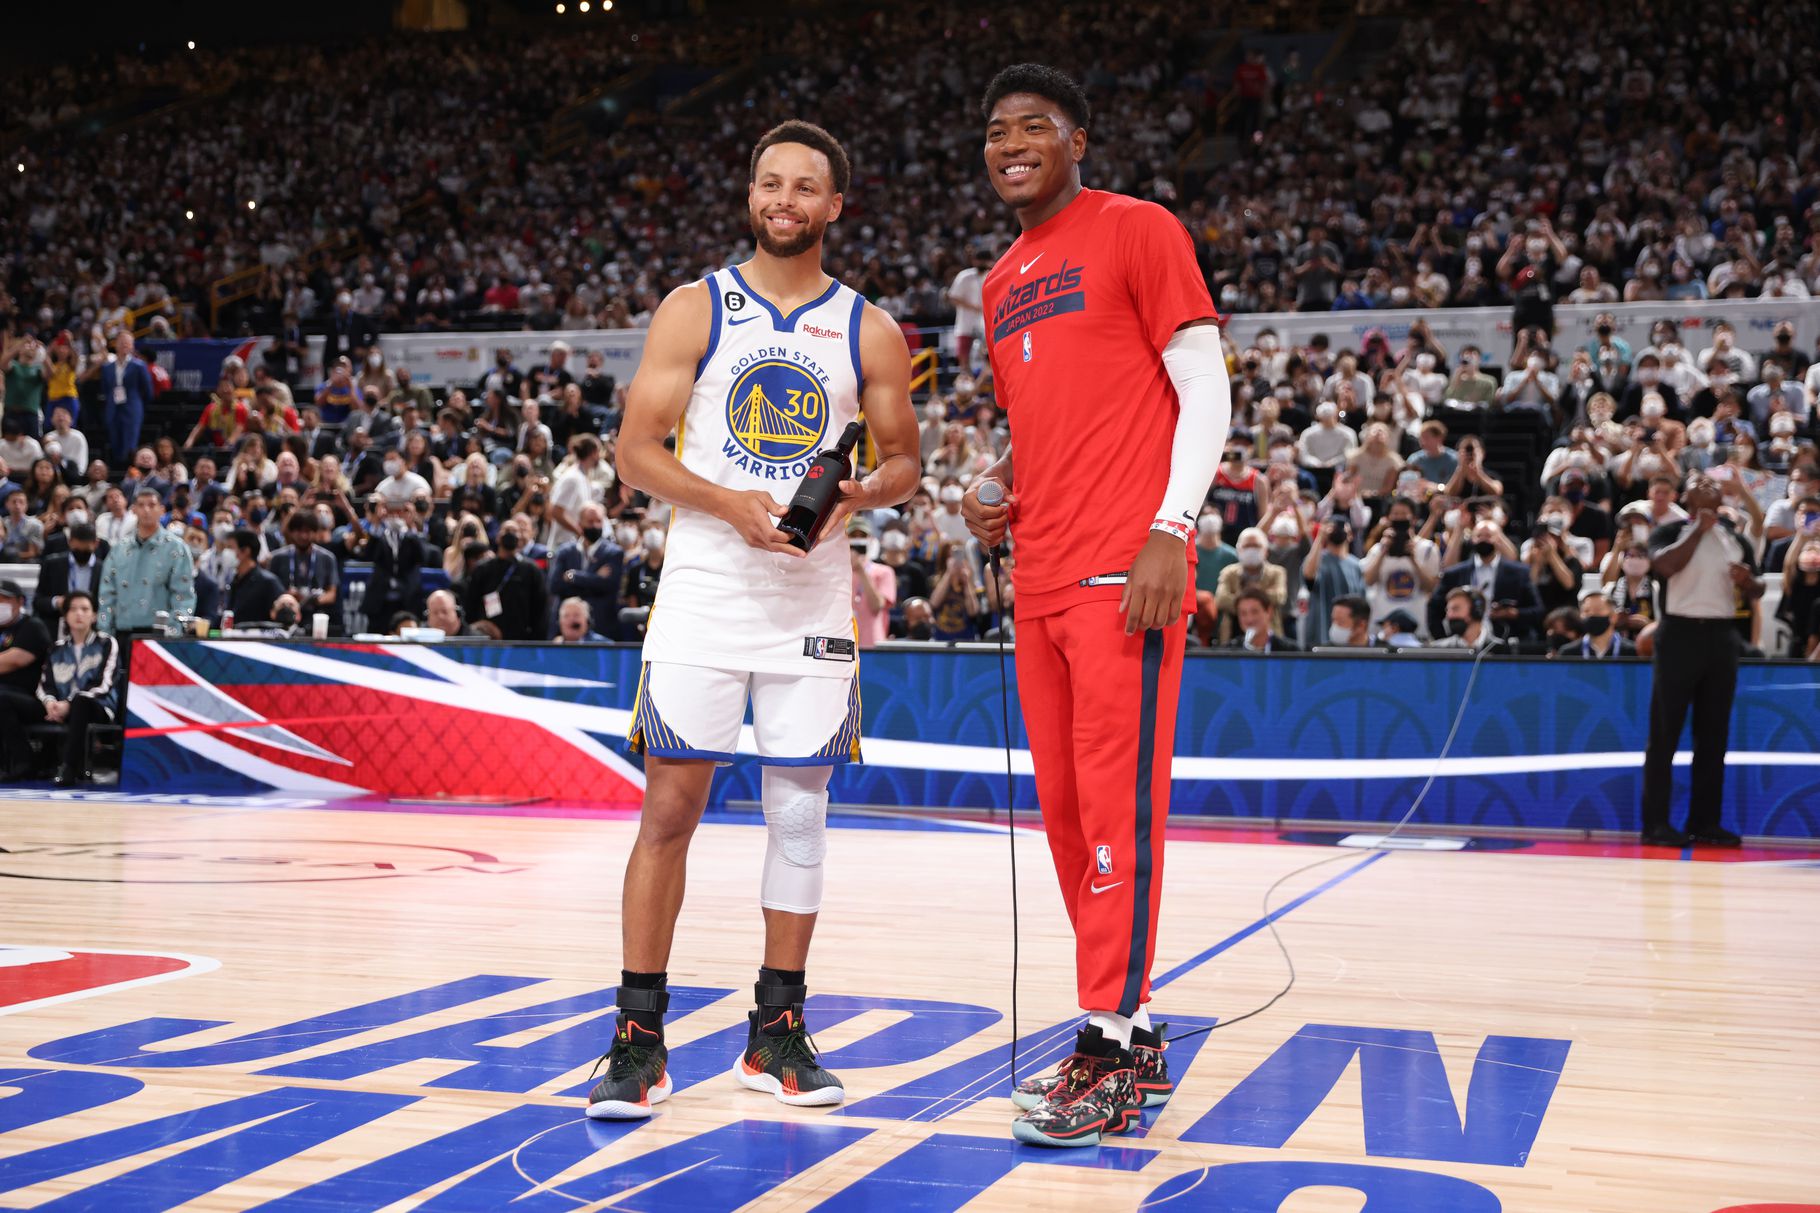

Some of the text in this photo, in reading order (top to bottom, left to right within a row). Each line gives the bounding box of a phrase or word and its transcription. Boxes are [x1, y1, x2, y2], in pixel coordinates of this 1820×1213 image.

[728, 294, 741, 309] 6
[803, 324, 843, 340] Rakuten
[1006, 302, 1054, 332] JAPAN 2022
[731, 347, 830, 384] GOLDEN STATE
[783, 388, 819, 420] 30
